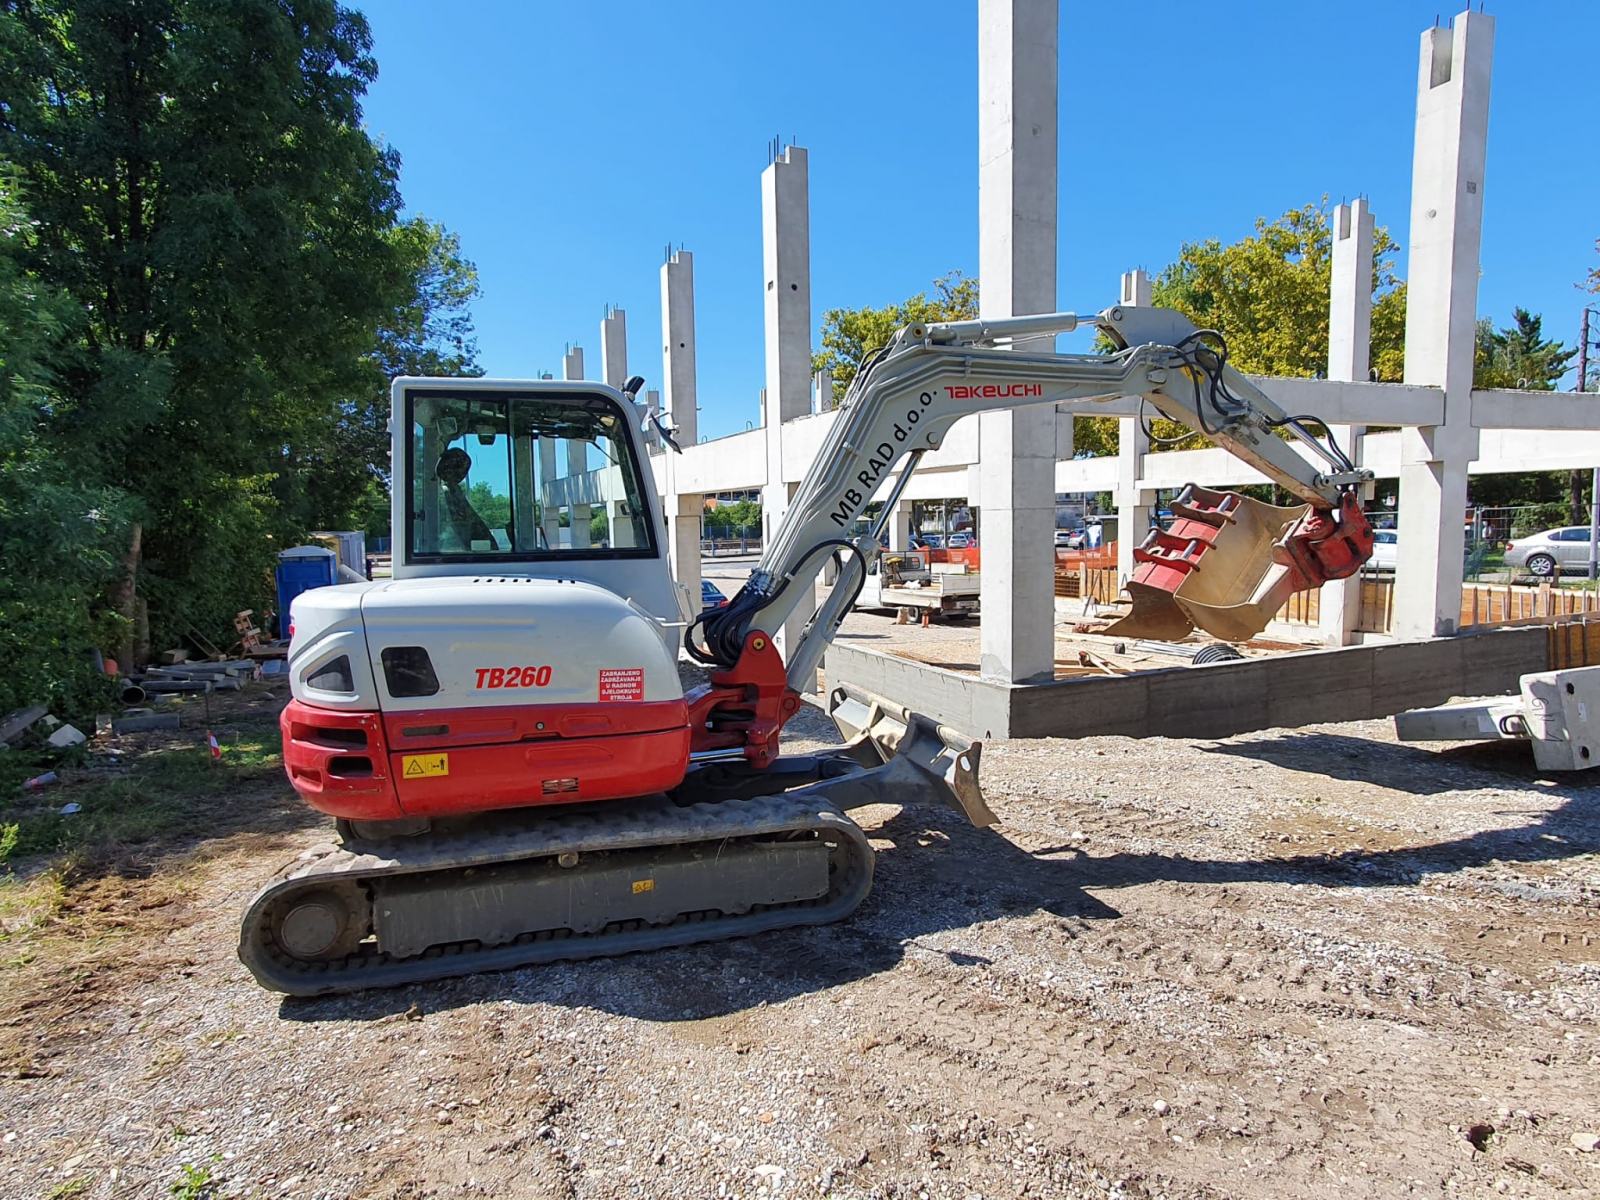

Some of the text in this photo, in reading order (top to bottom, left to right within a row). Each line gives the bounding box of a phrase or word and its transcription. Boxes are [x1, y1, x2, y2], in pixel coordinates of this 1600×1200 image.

[830, 391, 938, 527] MB RAD d.o.o.
[476, 665, 552, 689] TB260
